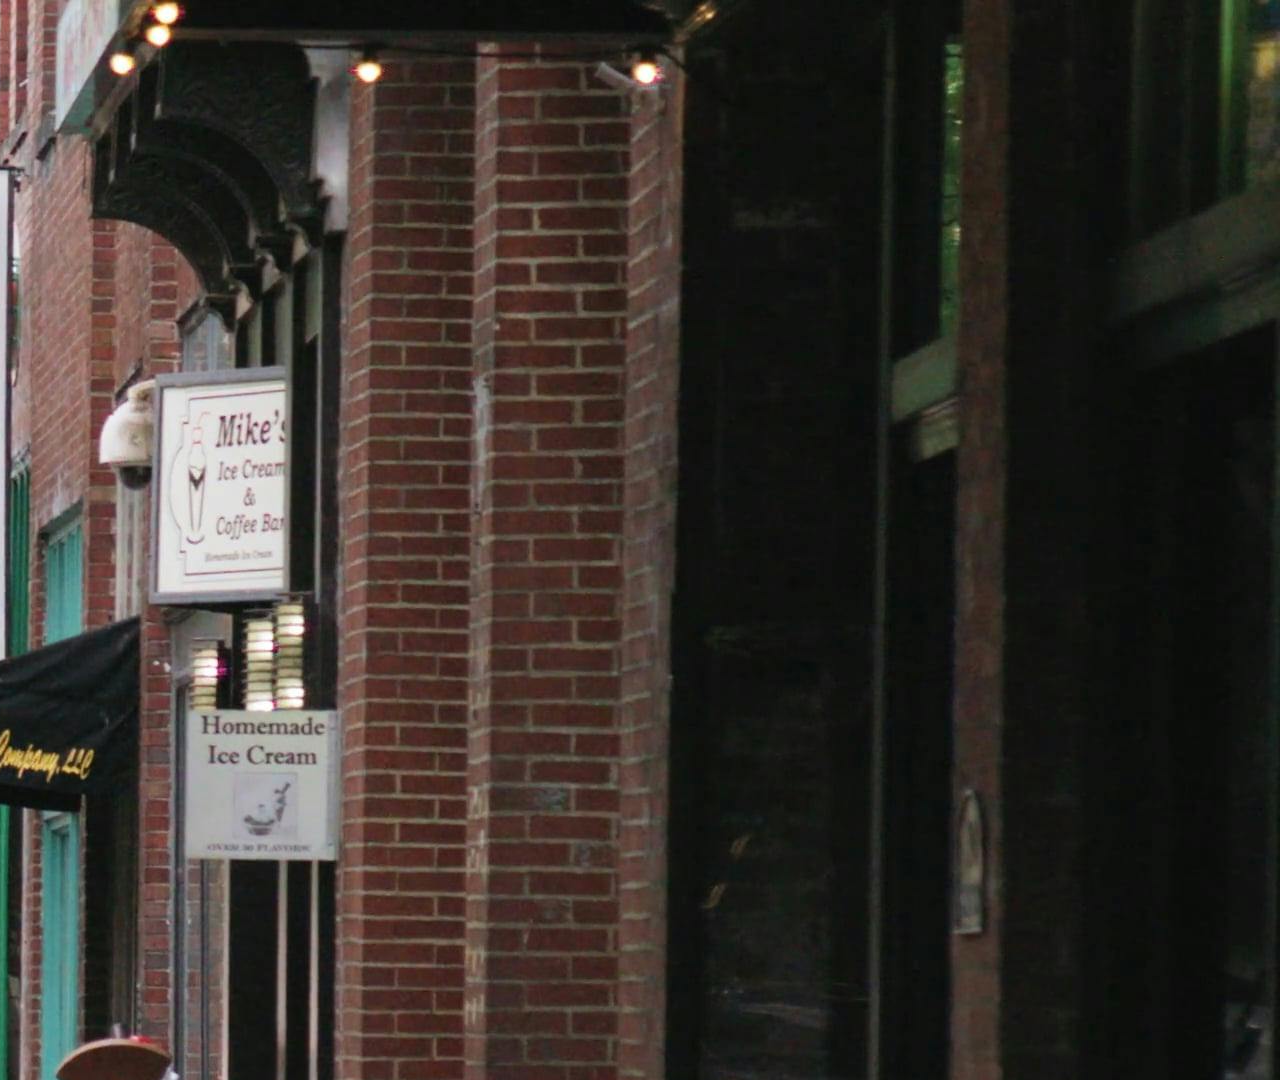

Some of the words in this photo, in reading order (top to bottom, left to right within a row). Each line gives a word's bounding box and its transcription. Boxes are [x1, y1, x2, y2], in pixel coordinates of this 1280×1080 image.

[216, 409, 286, 448] Mike's
[218, 461, 239, 481] Ice
[242, 459, 286, 479] Cream
[243, 487, 256, 506] &
[216, 514, 258, 540] Coffee
[261, 513, 285, 532] Bar
[201, 715, 325, 735] Homemade
[62, 747, 94, 780] LLC
[208, 745, 239, 765] Ice
[246, 745, 317, 765] Cream
